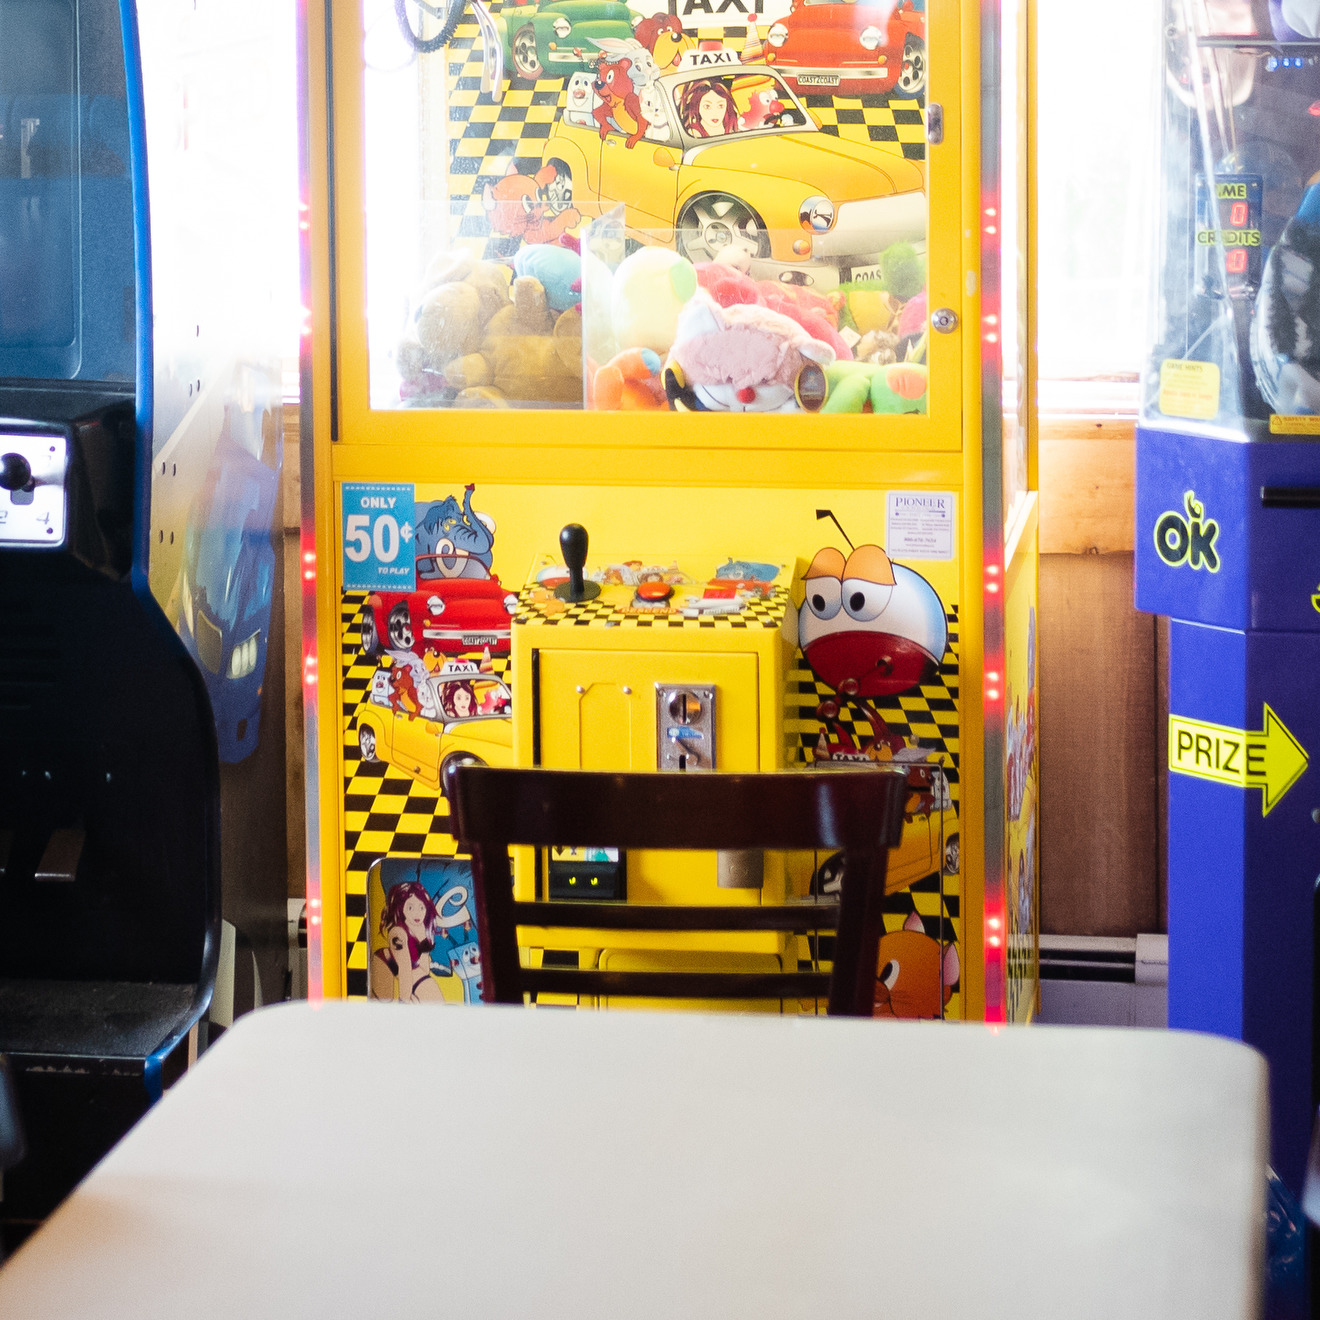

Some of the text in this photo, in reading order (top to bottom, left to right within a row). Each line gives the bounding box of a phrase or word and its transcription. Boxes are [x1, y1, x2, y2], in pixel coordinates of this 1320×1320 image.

[689, 51, 731, 66] TAXI
[797, 75, 839, 85] COAST2COAST
[1230, 202, 1248, 226] 0
[1197, 230, 1261, 244] CRDITS
[360, 496, 397, 509] ONLY
[895, 497, 945, 509] PIONEER
[36, 511, 50, 525] 4
[344, 513, 413, 563] 50¢
[377, 566, 411, 575] TO PLAY
[447, 664, 474, 672] TAXI
[1177, 728, 1267, 776] PRIZE
